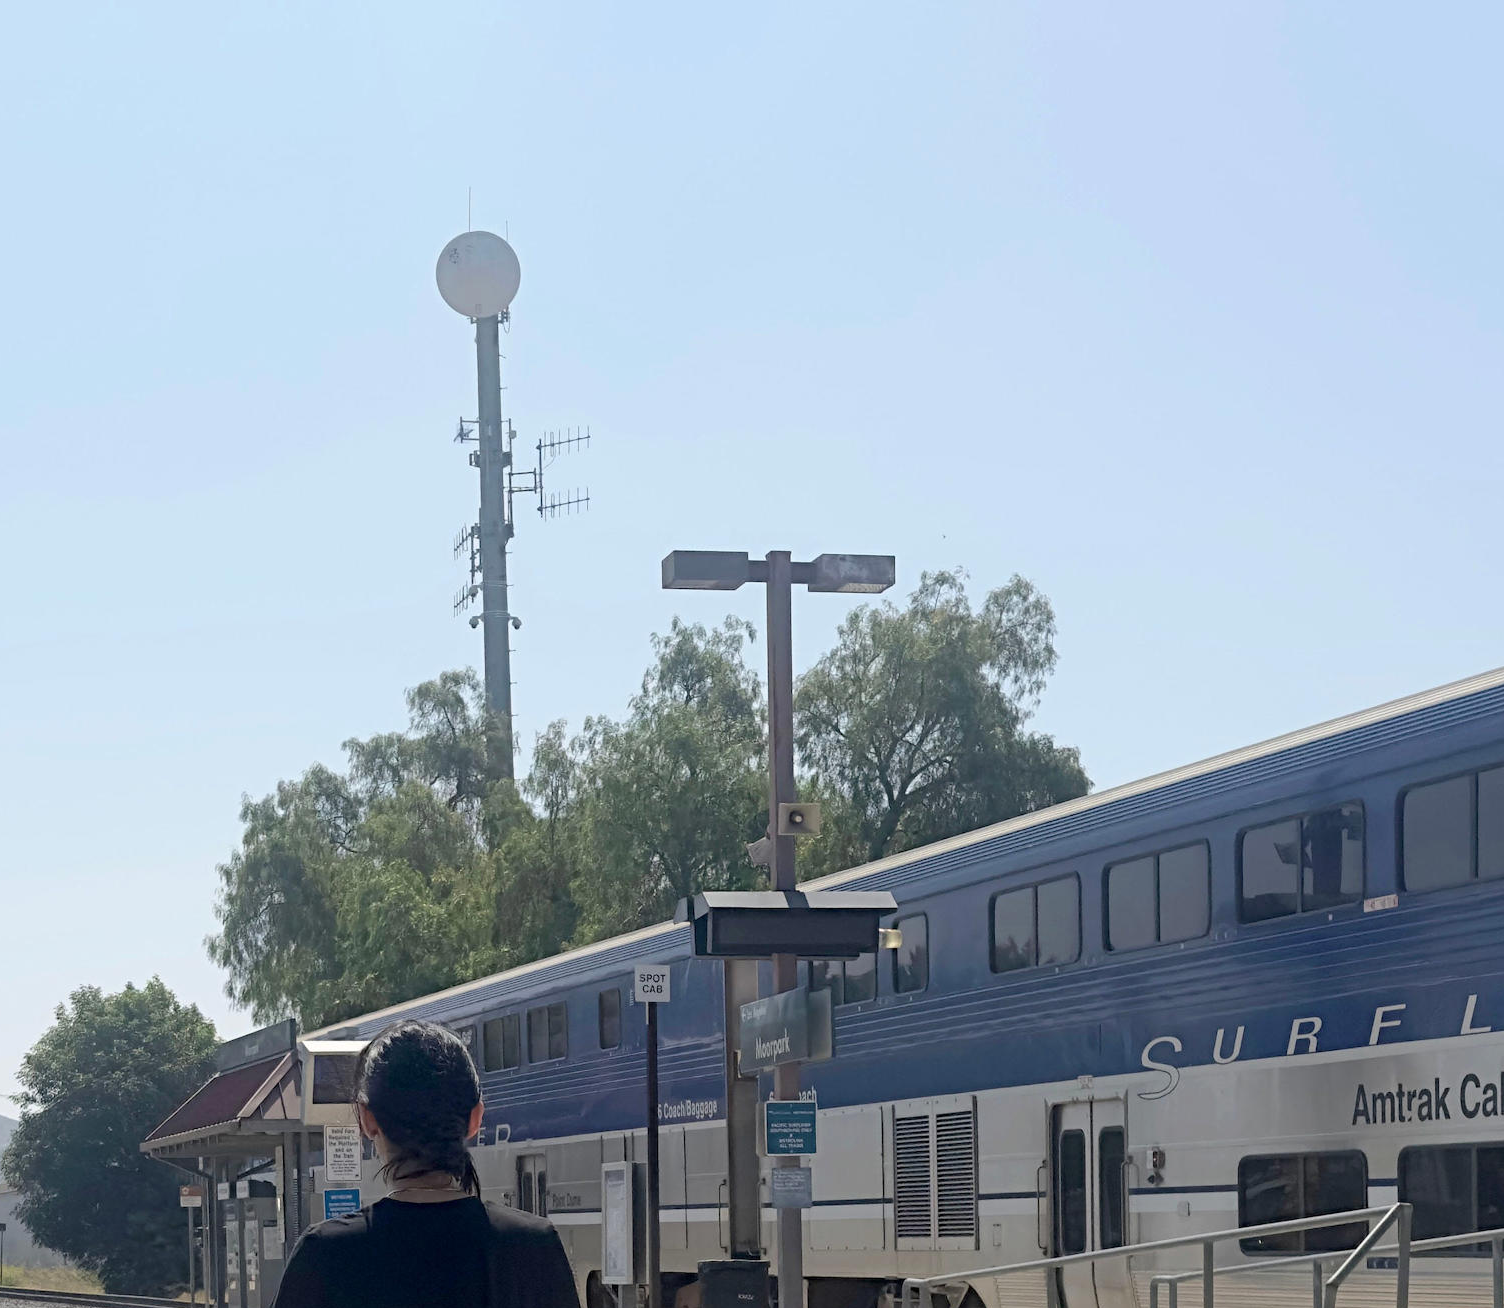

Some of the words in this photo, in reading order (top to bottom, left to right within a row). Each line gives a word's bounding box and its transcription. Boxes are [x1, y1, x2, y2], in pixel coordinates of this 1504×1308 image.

[639, 973, 666, 983] SPOT
[642, 984, 663, 994] CAB
[755, 1028, 791, 1063] Moorpark
[1351, 1077, 1451, 1126] Amtrak
